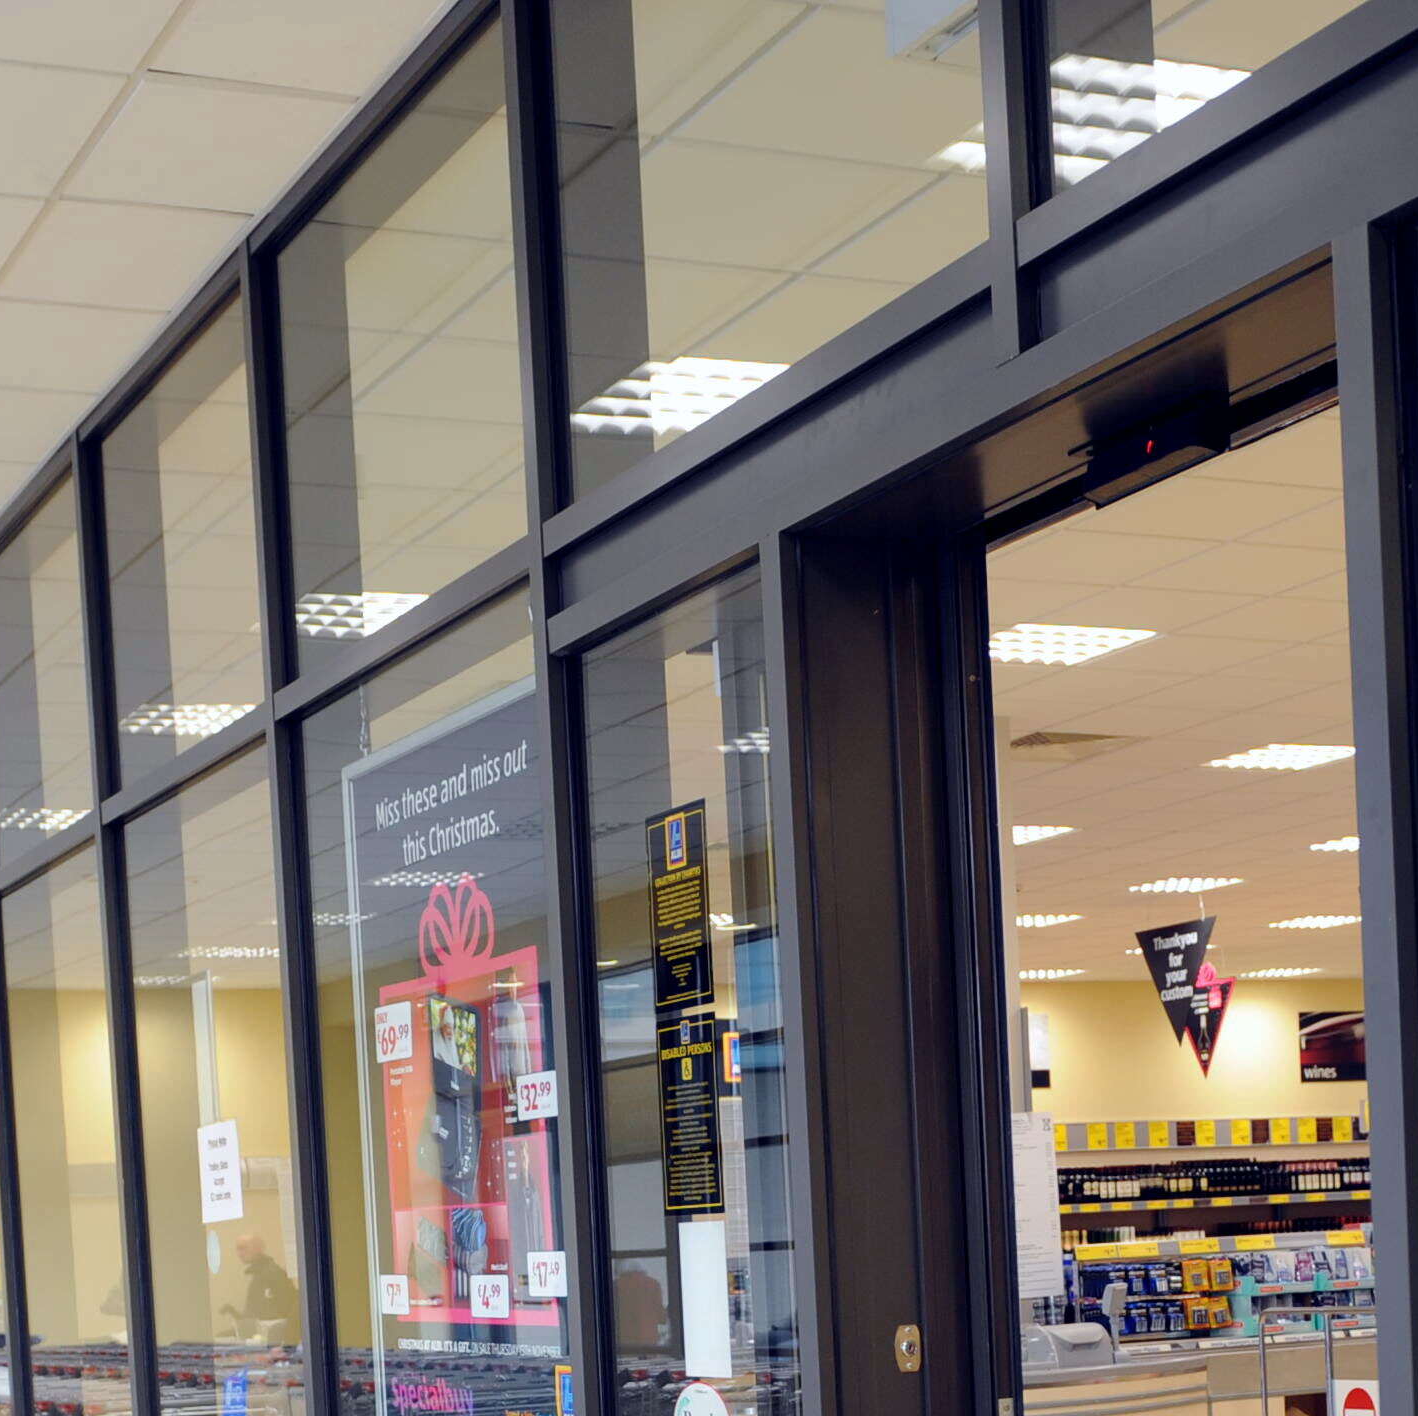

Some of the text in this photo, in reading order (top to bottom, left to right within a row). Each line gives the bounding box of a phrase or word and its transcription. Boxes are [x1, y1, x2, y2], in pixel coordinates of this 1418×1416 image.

[375, 740, 528, 831] Miss these and miss out
[402, 809, 500, 866] this Christmas.
[1168, 952, 1184, 968] for
[1165, 968, 1188, 988] your
[1161, 985, 1193, 1002] custom
[1304, 1064, 1338, 1079] wines
